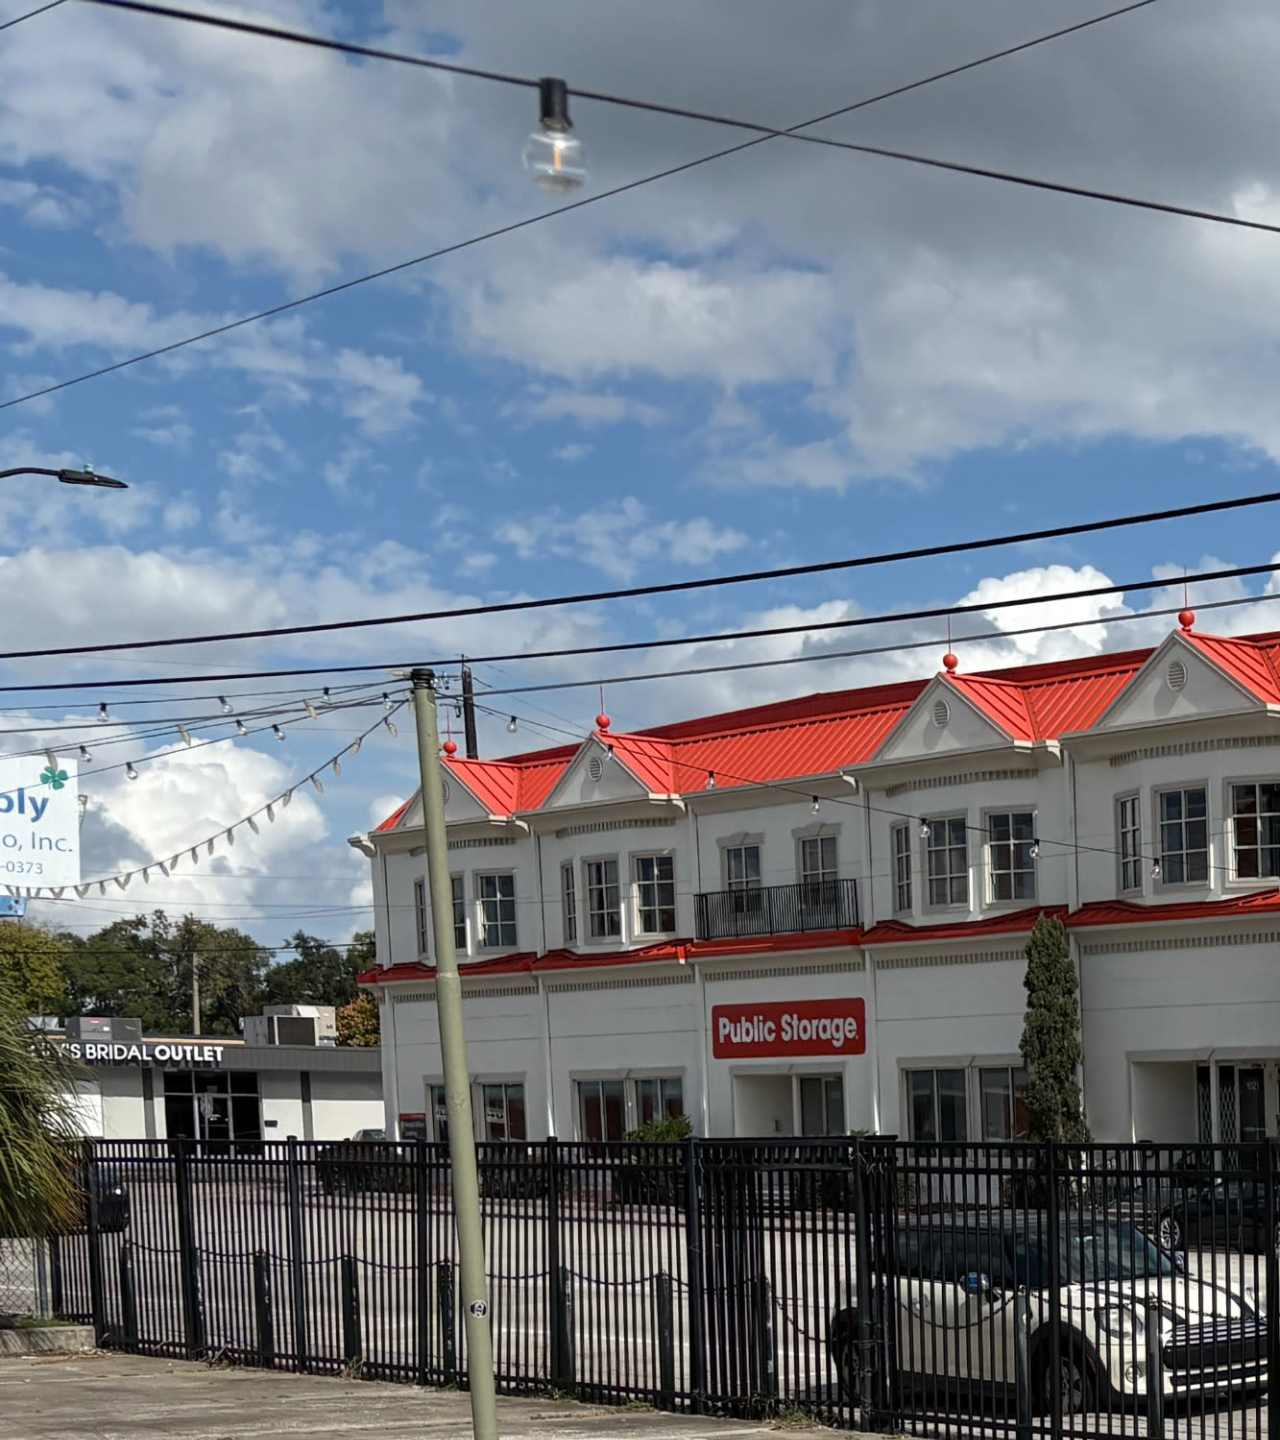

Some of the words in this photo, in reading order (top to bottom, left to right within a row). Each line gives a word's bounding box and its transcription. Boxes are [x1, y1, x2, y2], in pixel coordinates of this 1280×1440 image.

[31, 831, 73, 852] Inc.
[719, 1016, 776, 1043] Public
[780, 1013, 858, 1048] Storage
[86, 1043, 152, 1061] BRIDAL
[154, 1045, 224, 1062] OUTLET
